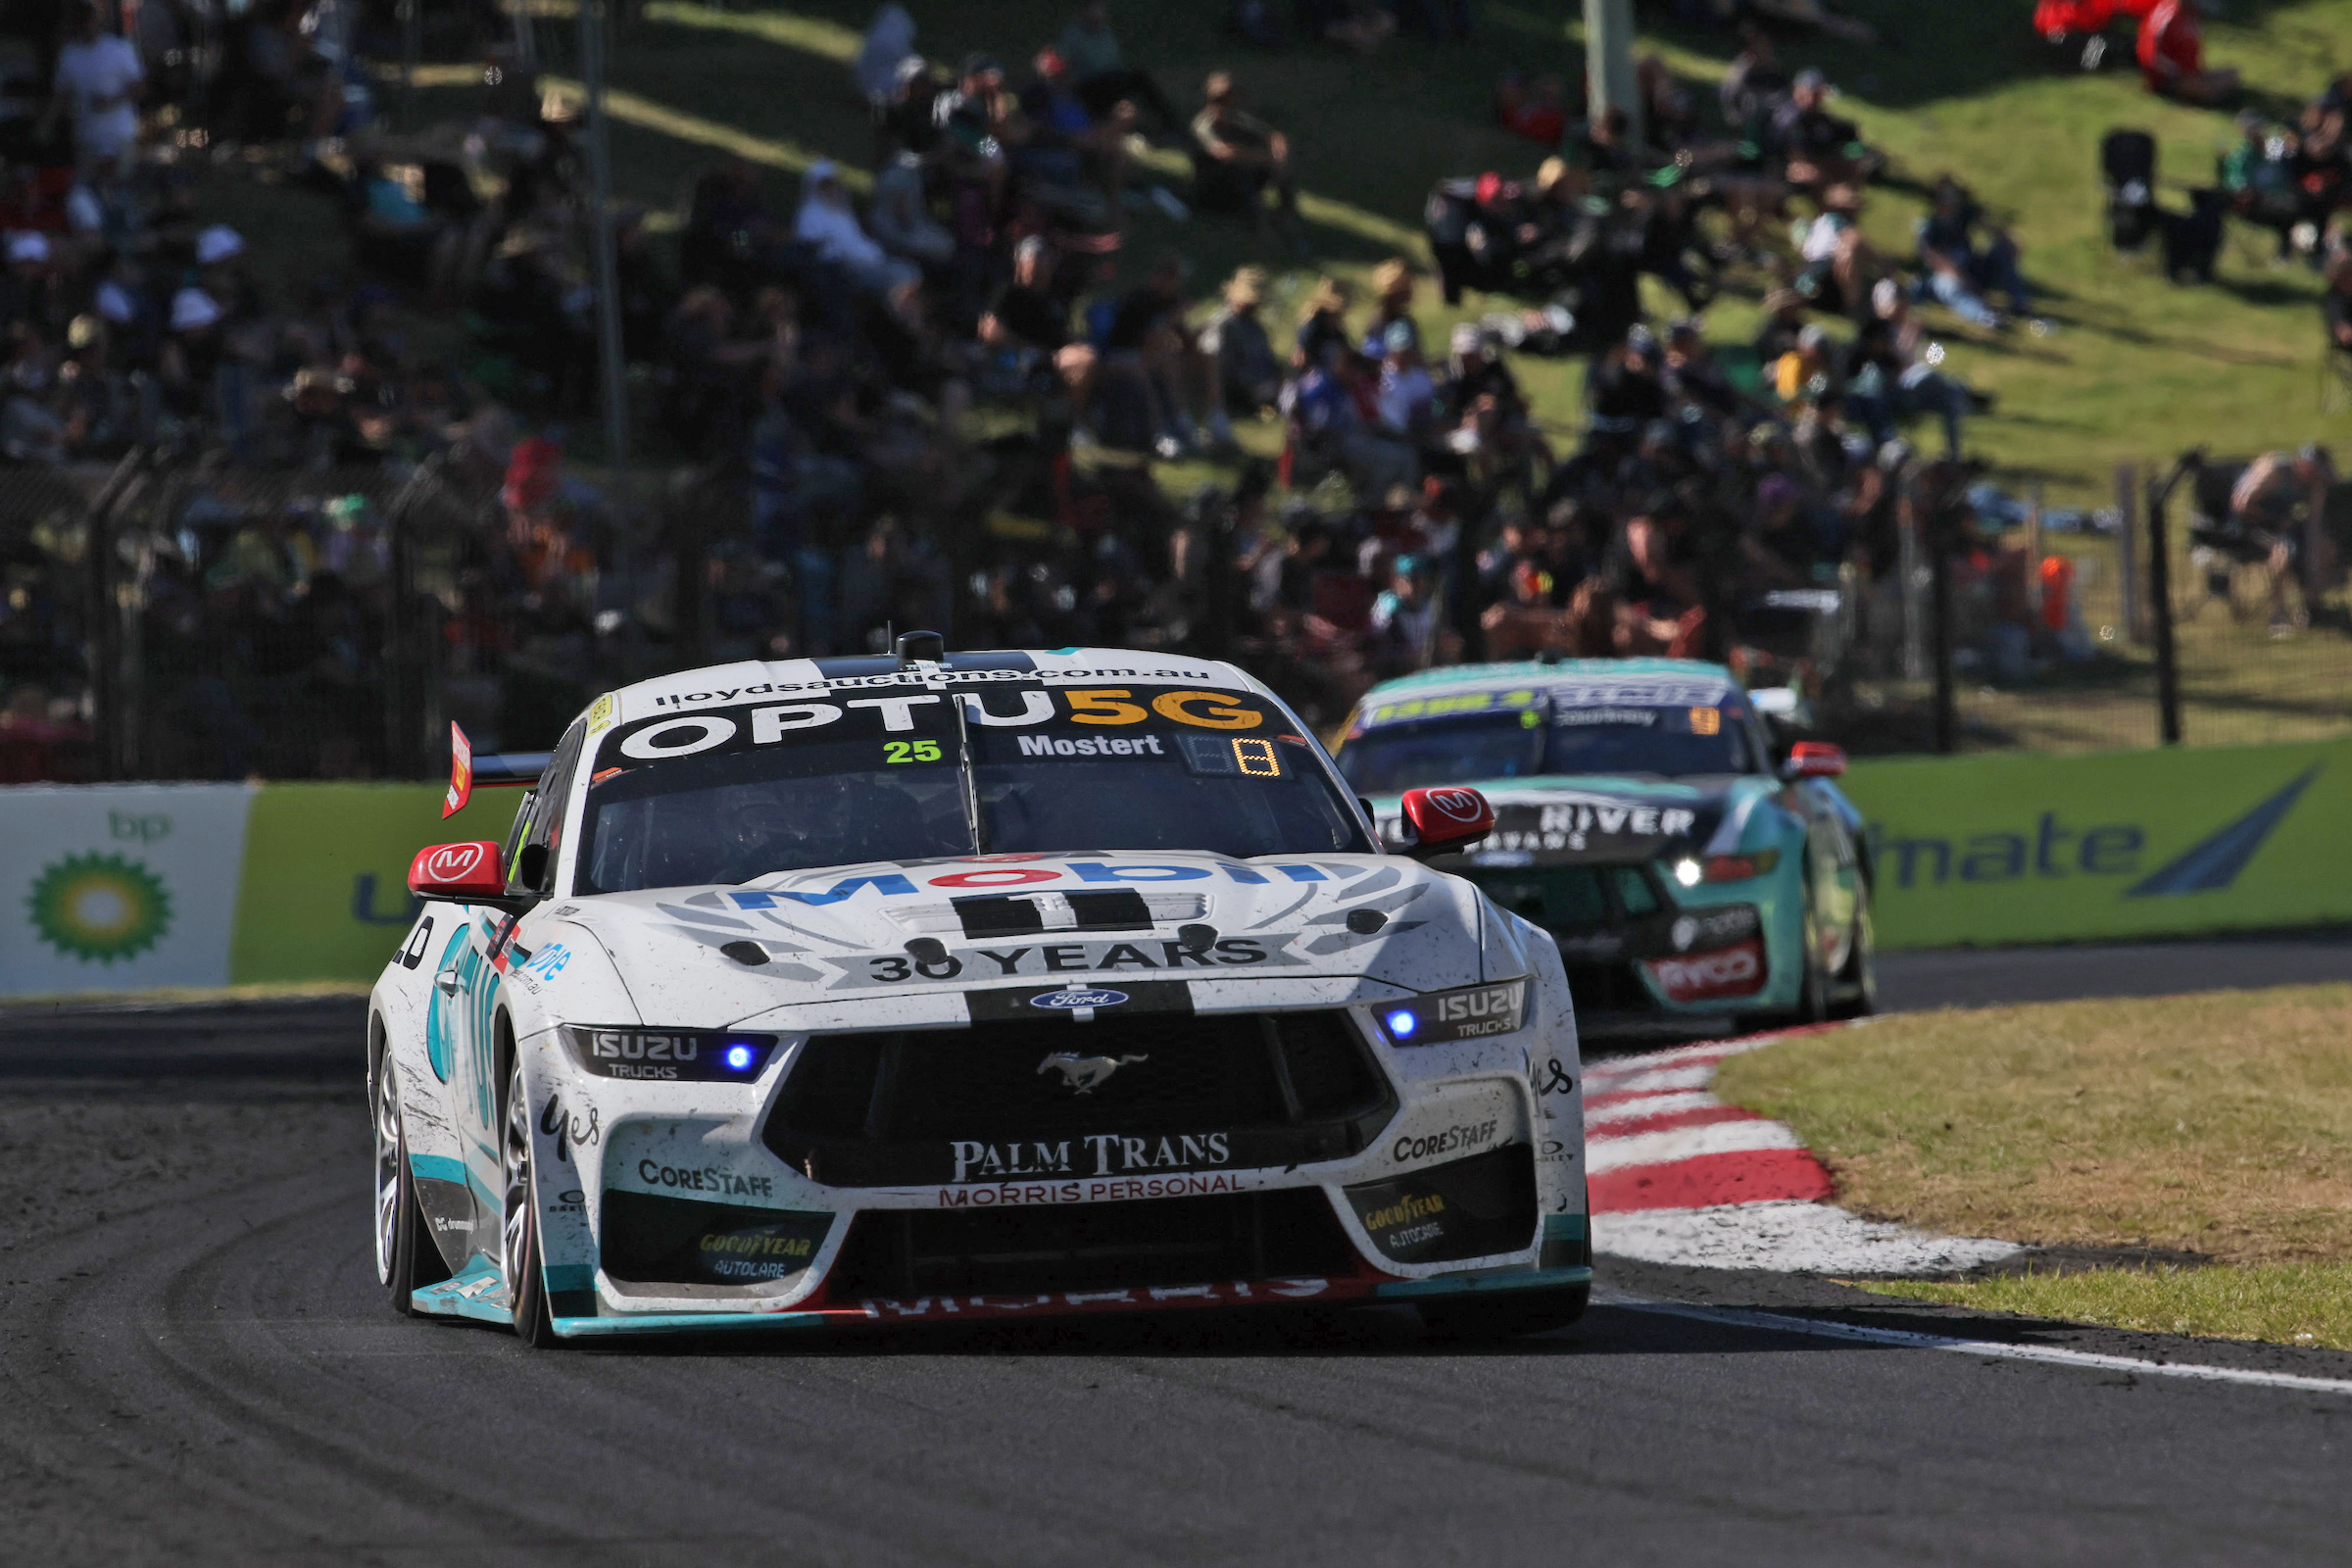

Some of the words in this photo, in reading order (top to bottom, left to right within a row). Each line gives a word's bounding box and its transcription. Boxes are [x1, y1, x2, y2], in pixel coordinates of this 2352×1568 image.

[655, 667, 1210, 707] lloydsauctions.com.au
[883, 739, 943, 764] 25
[1017, 734, 1164, 757] Mostert
[104, 807, 173, 848] bp
[1541, 805, 1695, 835] RIVER
[868, 953, 964, 982] 30
[976, 938, 1268, 975] YEARS
[1438, 985, 1522, 1022] ISUZU
[1456, 1017, 1512, 1039] TRUCKS
[591, 1032, 699, 1062] ISUZU
[608, 1062, 678, 1079] TRUCKS
[939, 1184, 1082, 1208] MORRIS
[1090, 1174, 1248, 1201] PERSONAL
[1364, 1194, 1446, 1231] GOODYEAR
[699, 1229, 811, 1257] GOODYEAR
[713, 1258, 786, 1280] AUTOCARE
